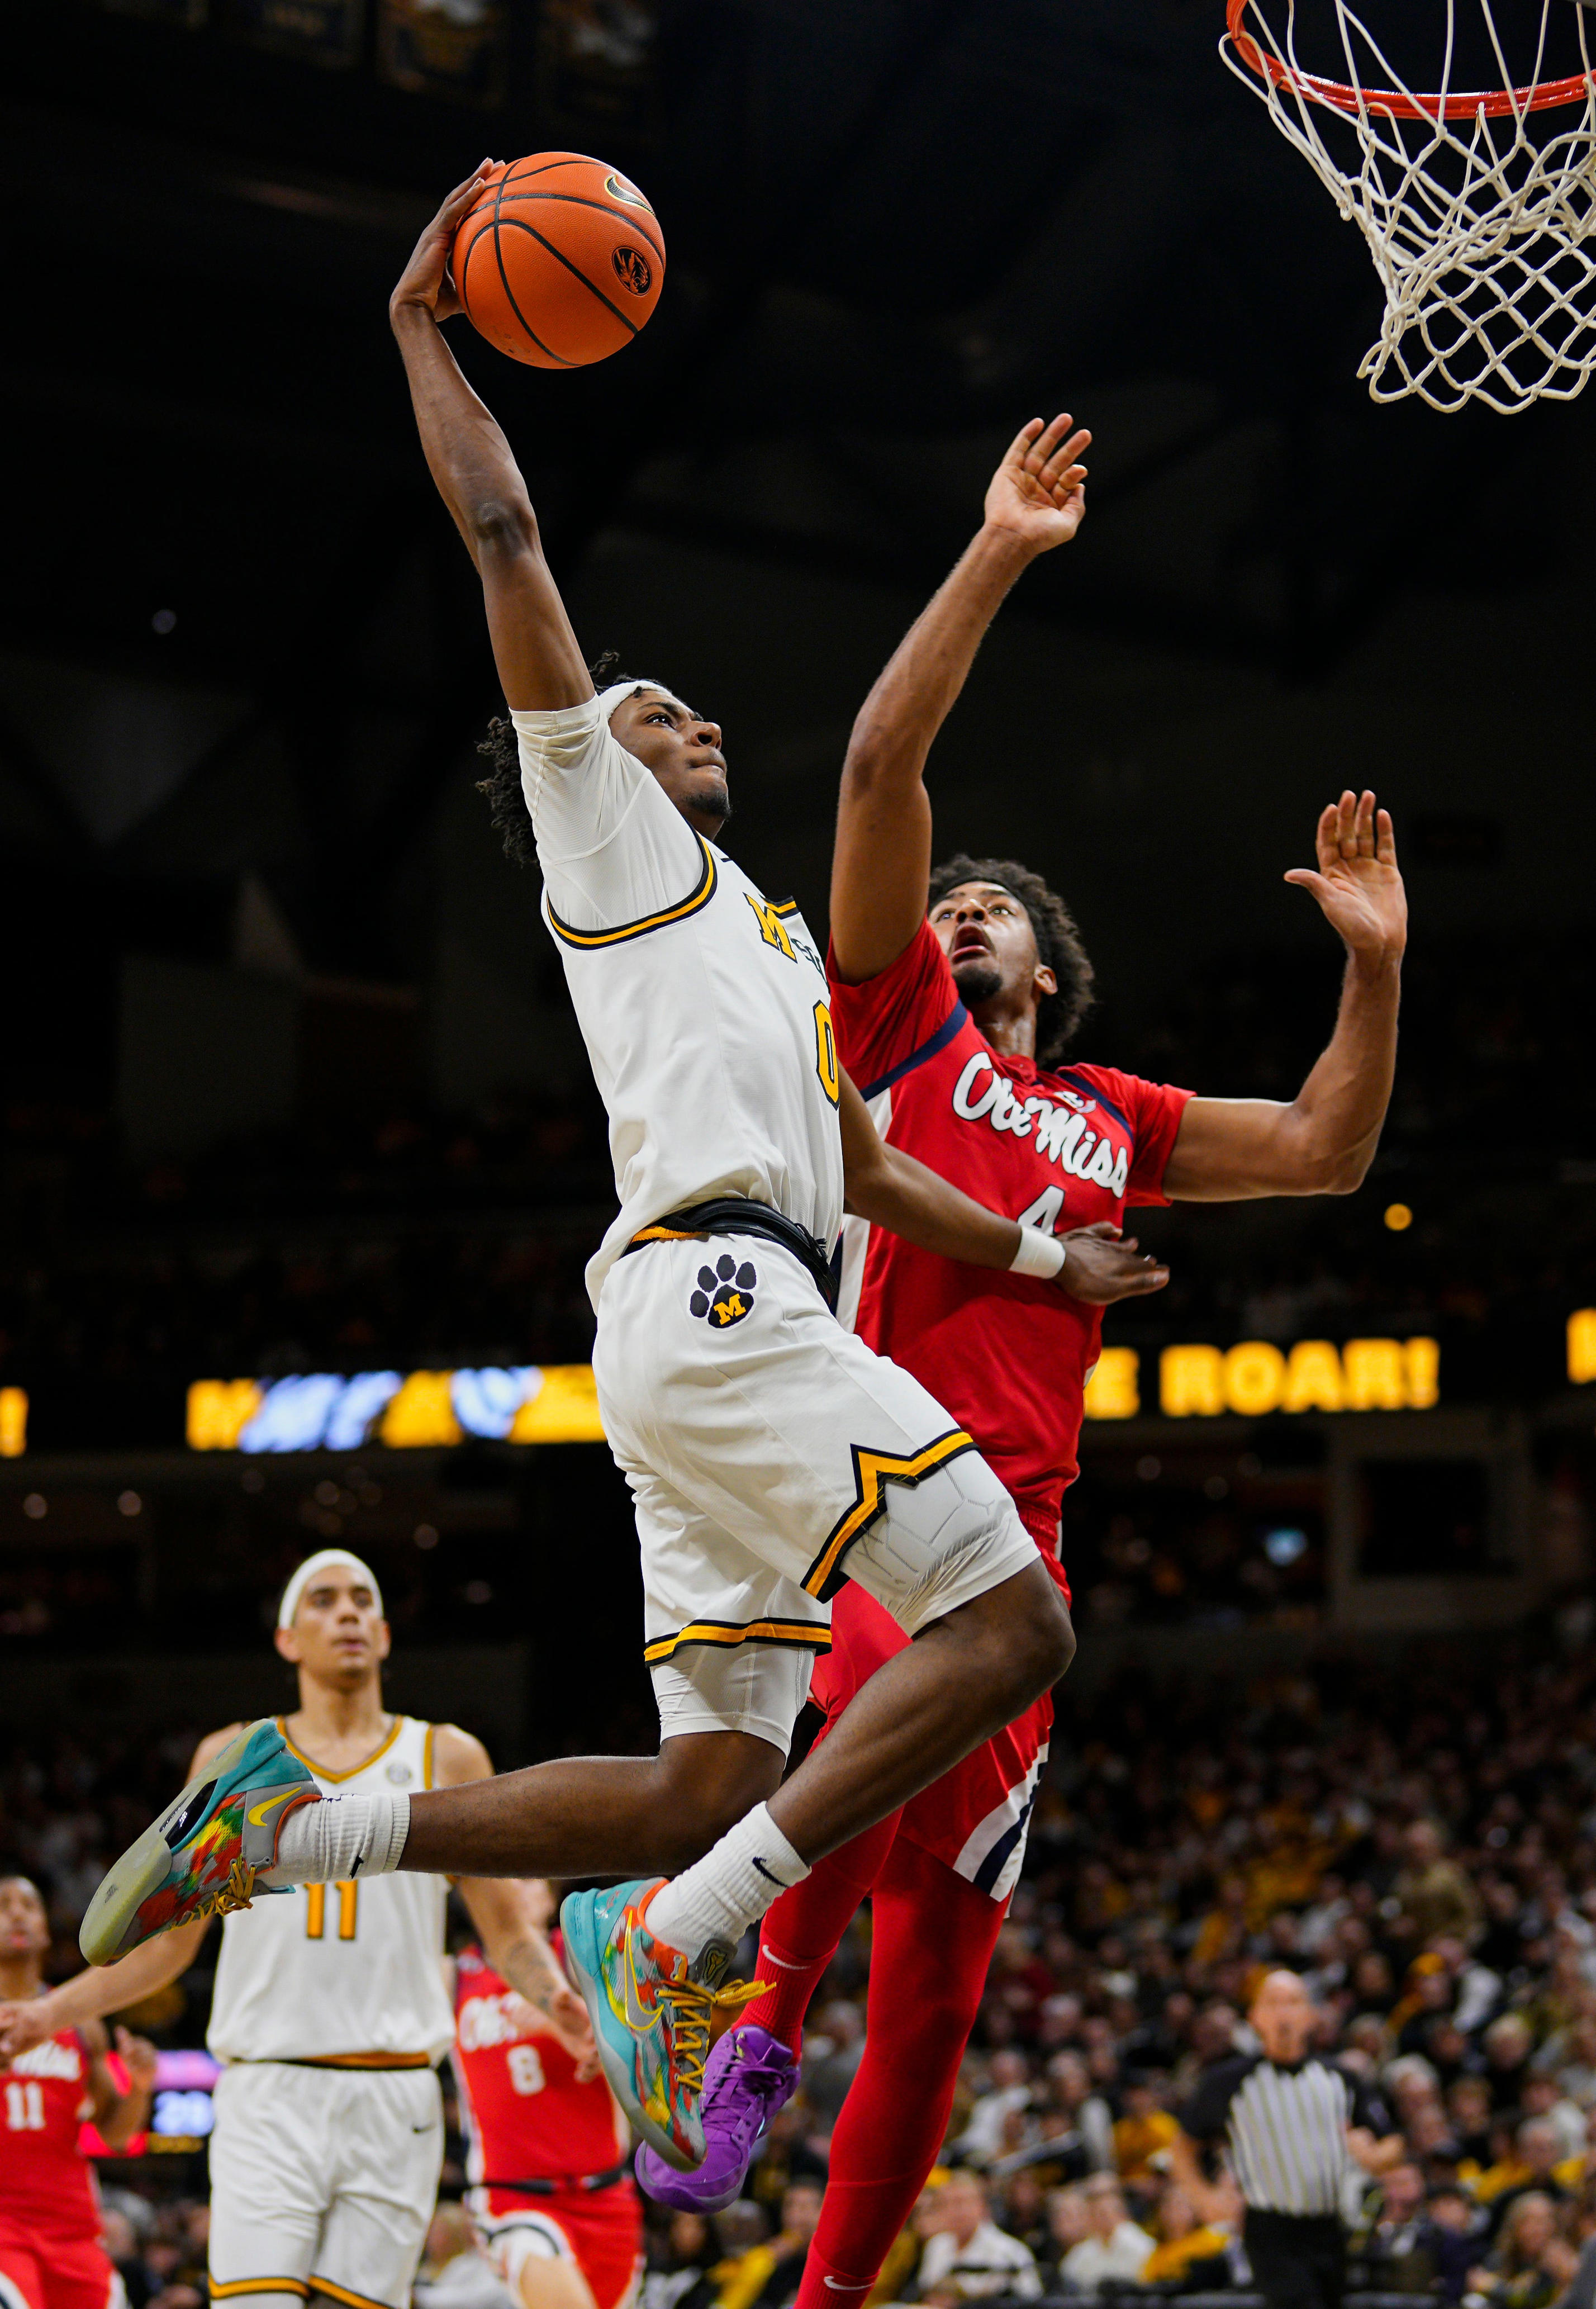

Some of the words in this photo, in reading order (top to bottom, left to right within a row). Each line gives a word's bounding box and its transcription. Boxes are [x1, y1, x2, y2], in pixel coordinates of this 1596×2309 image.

[813, 999, 840, 1112] 0
[952, 1051, 1032, 1138] Ole
[1024, 1096, 1129, 1199] Miss
[1017, 1184, 1065, 1237] 4
[713, 1293, 747, 1325] M
[1159, 1336, 1440, 1417] ROAR!
[304, 1880, 358, 1940] 11
[6, 2082, 46, 2132] 11
